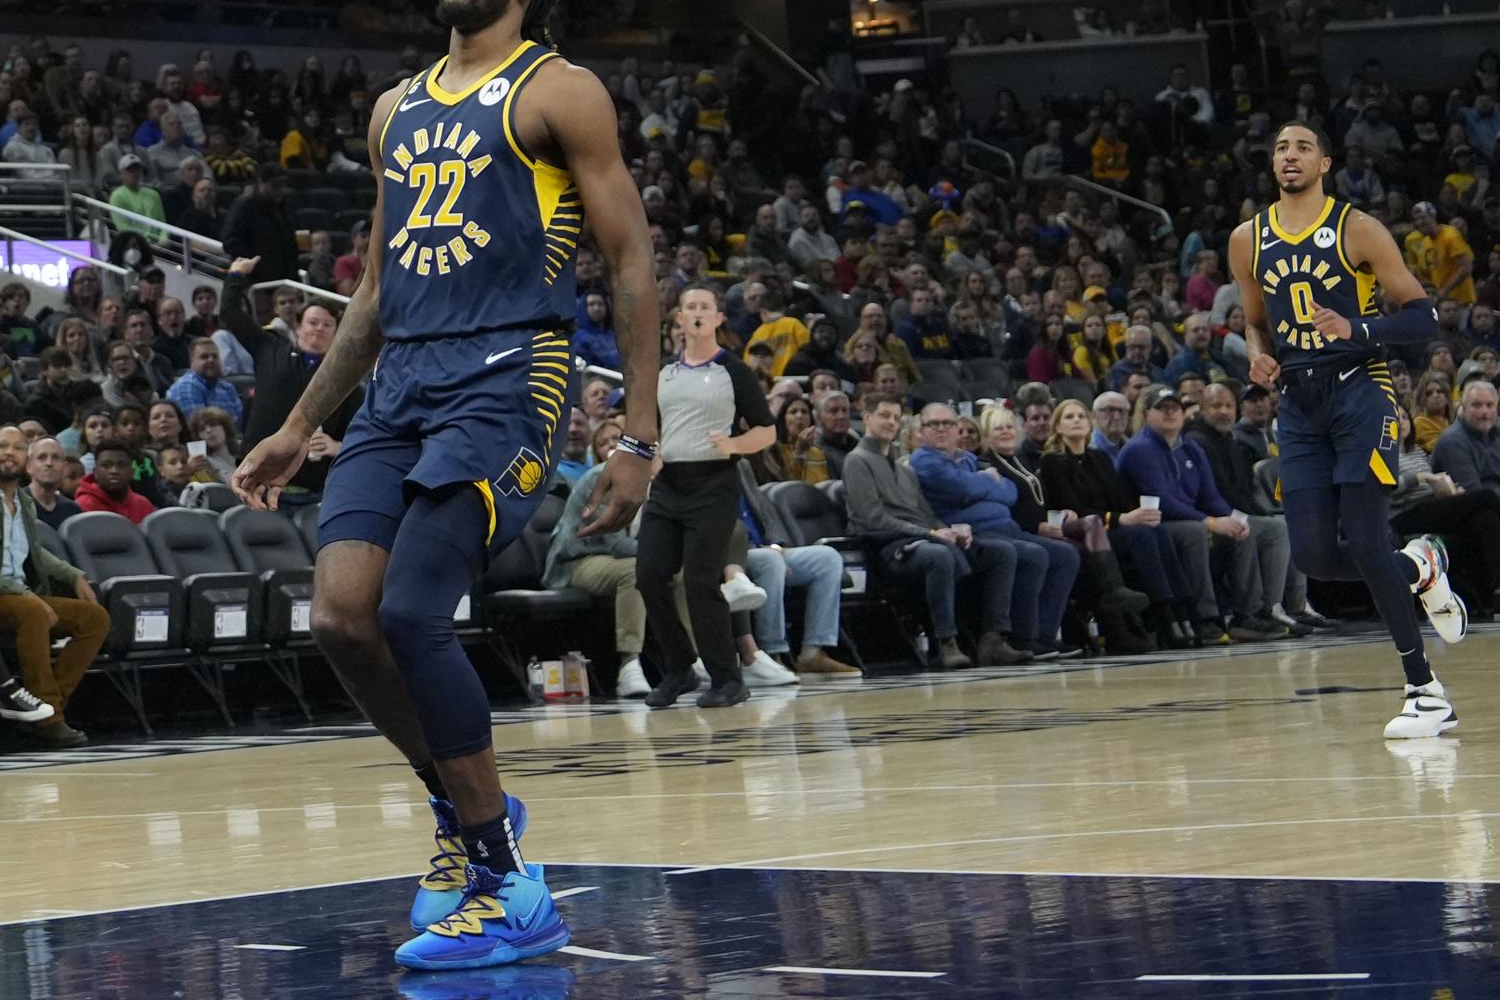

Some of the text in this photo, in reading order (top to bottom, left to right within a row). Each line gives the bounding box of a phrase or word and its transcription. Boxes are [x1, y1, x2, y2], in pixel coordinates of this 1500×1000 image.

[384, 122, 492, 184] INDIANA
[406, 160, 466, 230] 22
[389, 220, 492, 275] PACERS
[1263, 254, 1342, 295] INDIANA
[1290, 281, 1316, 324] 0
[1277, 319, 1338, 350] PACE
